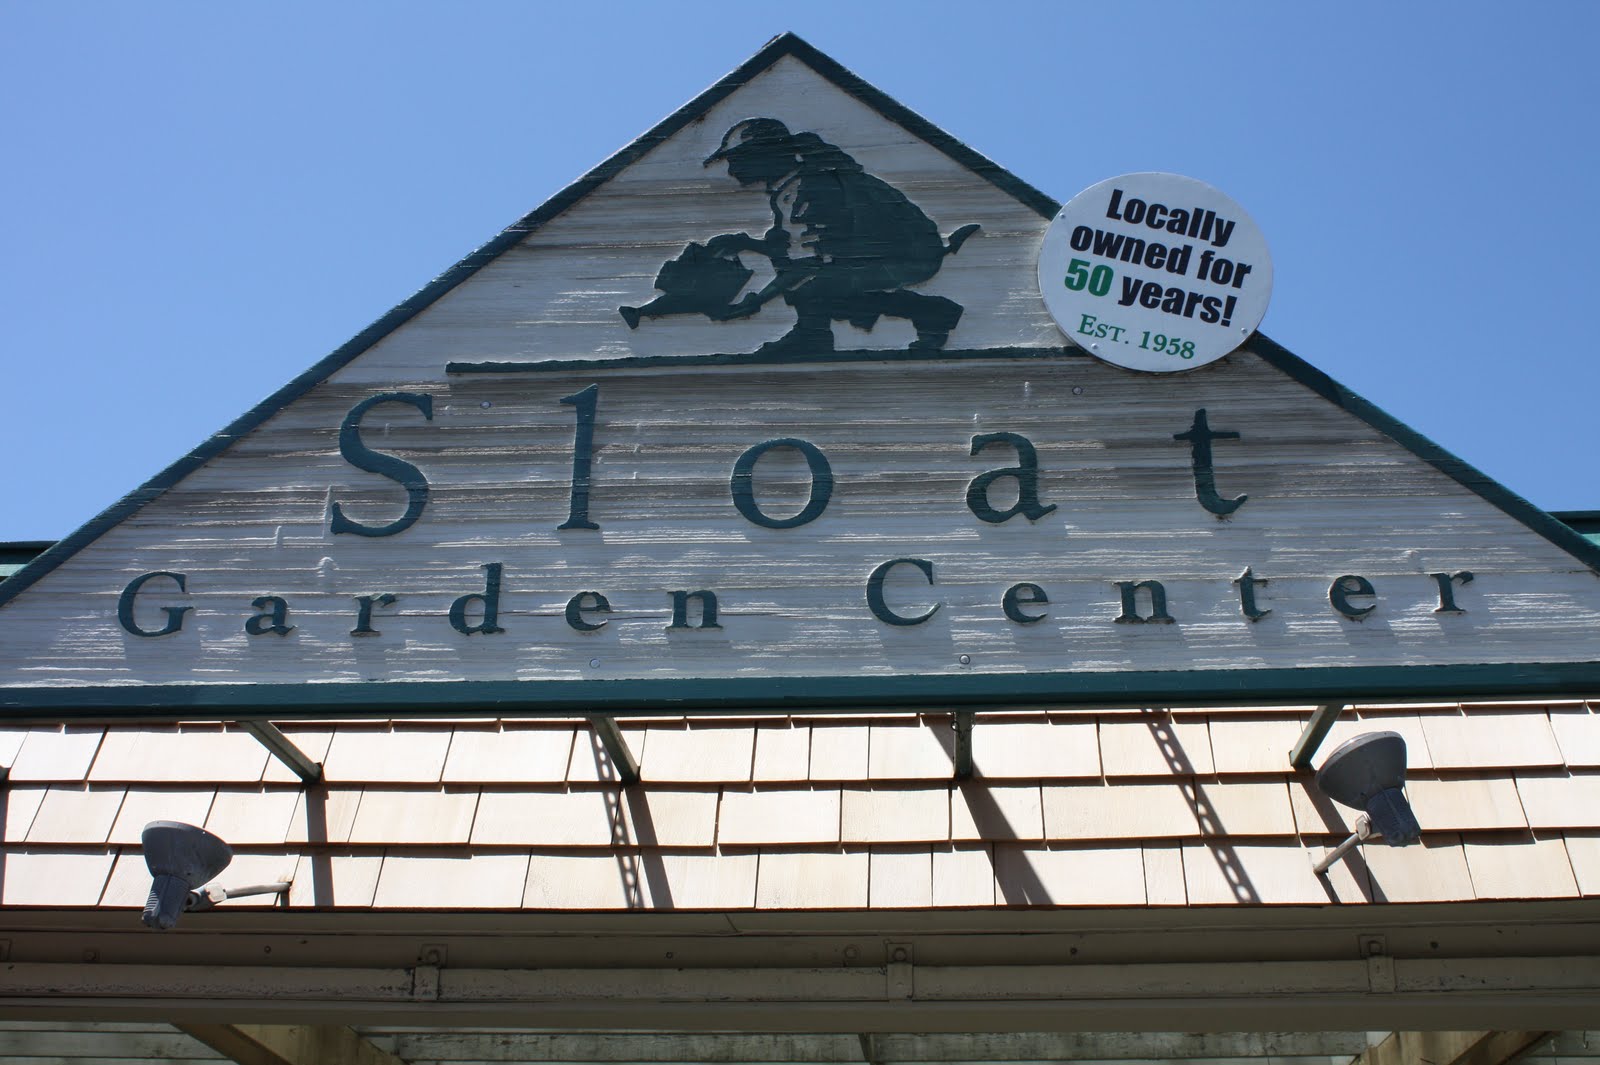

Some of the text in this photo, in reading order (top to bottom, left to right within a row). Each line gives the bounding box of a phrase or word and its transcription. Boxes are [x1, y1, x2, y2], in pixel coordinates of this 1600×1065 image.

[1106, 189, 1236, 247] Locally
[1070, 225, 1252, 289] owned for
[1064, 258, 1237, 327] 50 years!
[1138, 331, 1196, 360] 1958
[330, 383, 1248, 537] Sloat
[117, 557, 1474, 637] Garden Center
